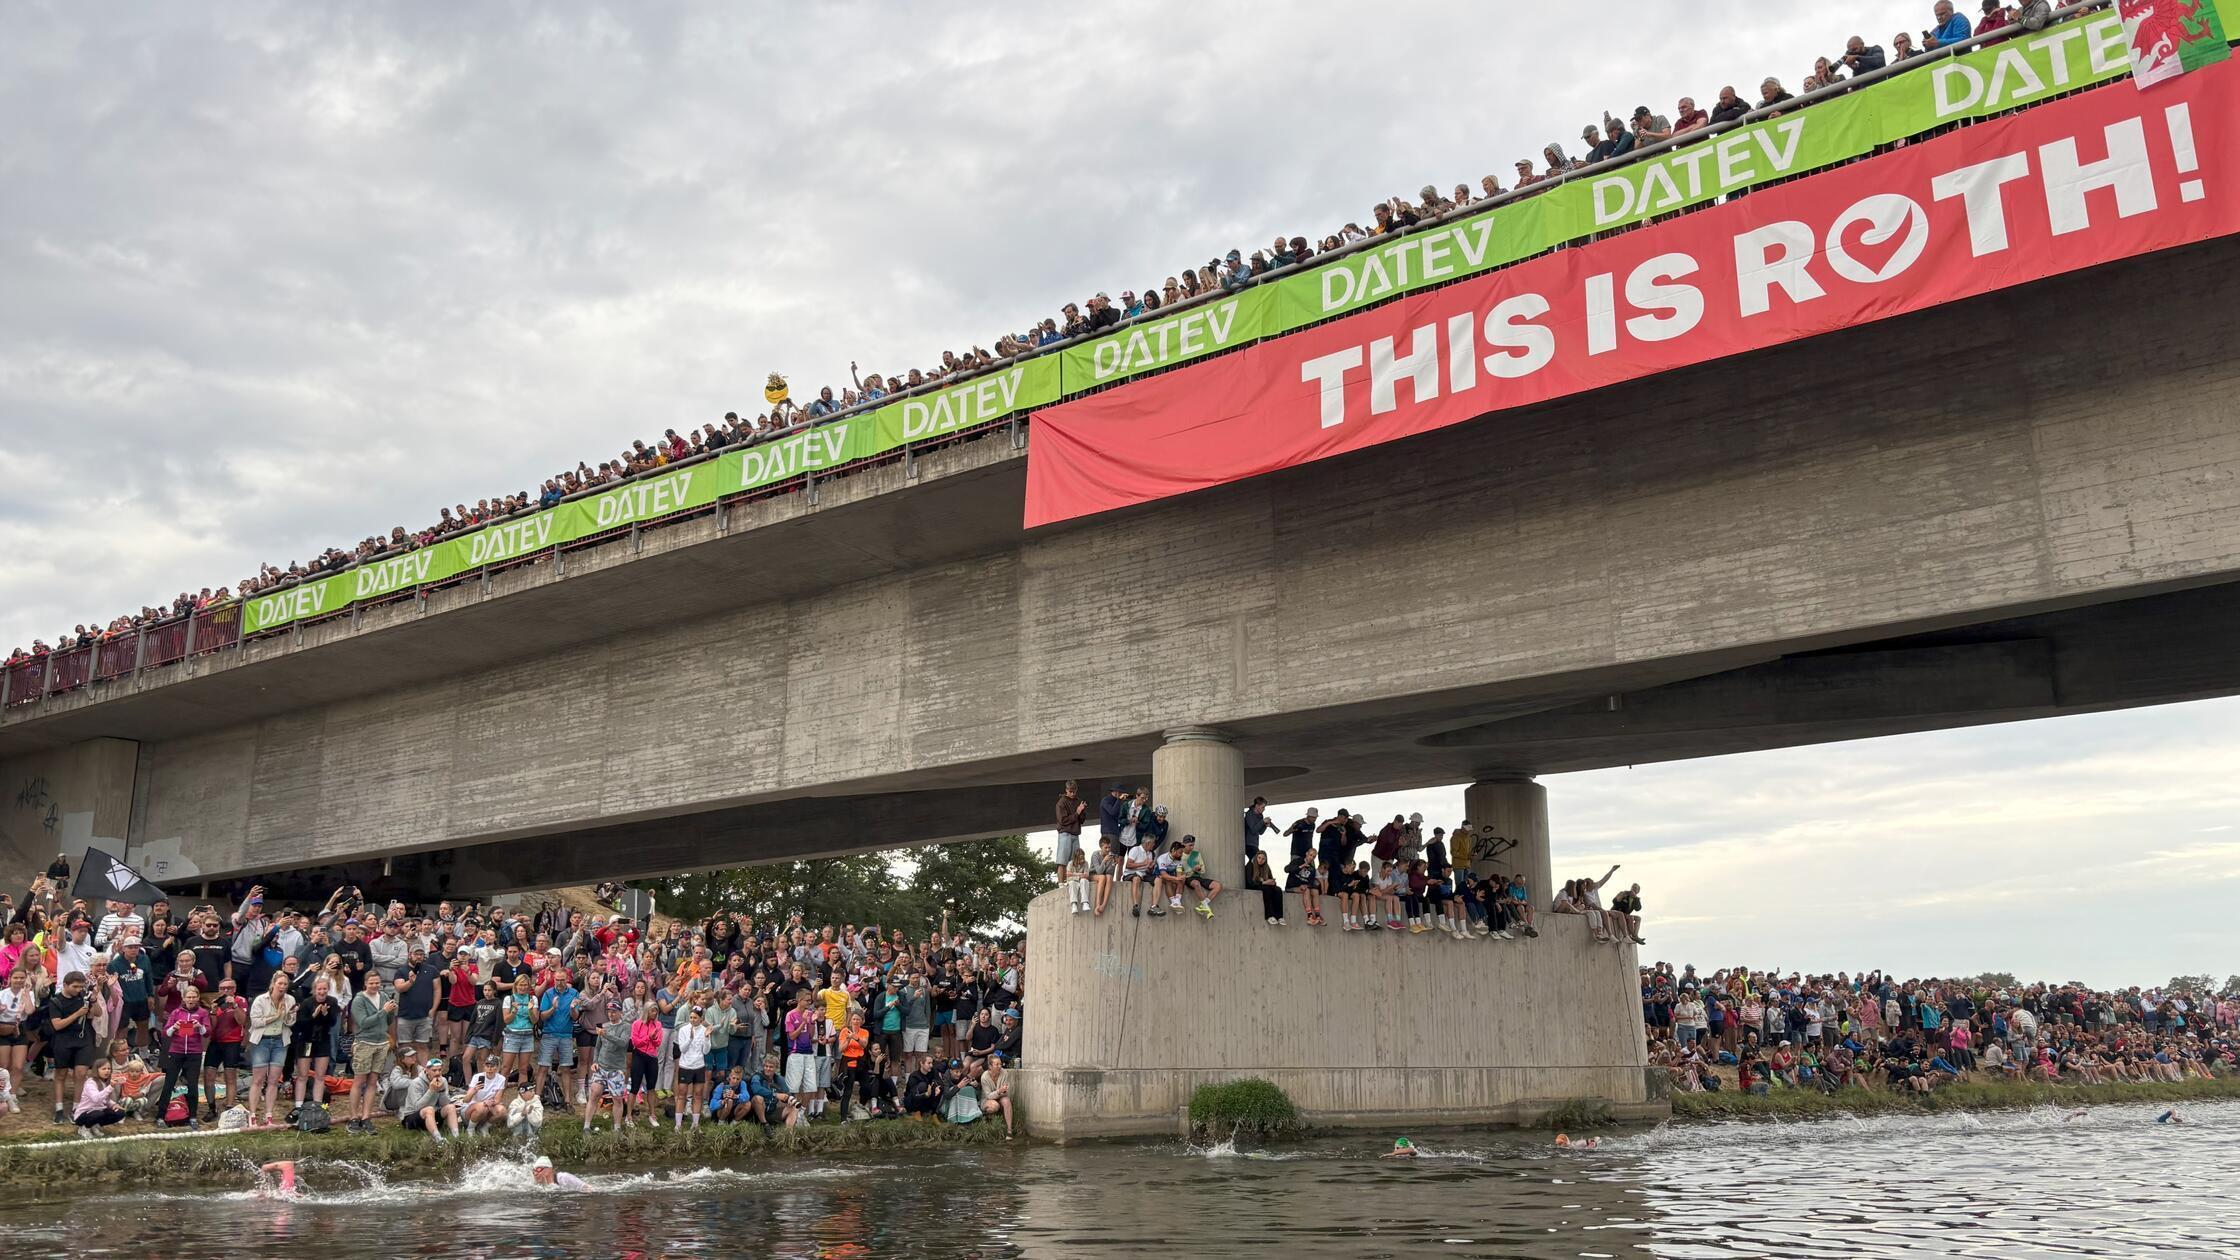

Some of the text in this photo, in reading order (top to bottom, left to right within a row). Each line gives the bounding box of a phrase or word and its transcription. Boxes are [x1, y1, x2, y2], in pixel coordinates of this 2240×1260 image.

[1931, 15, 2132, 118] DATE
[1593, 117, 1805, 225] DATEV
[1301, 102, 2206, 429] THIS IS ROTH!
[1321, 218, 1495, 312] DATEV
[1095, 301, 1238, 379] DATEV
[904, 368, 1024, 439] DATEV
[740, 425, 849, 487] DATEV
[598, 473, 693, 528] DATEV
[357, 551, 433, 597] DATEV
[471, 513, 554, 564] DATEV
[259, 584, 327, 626] DATEV
